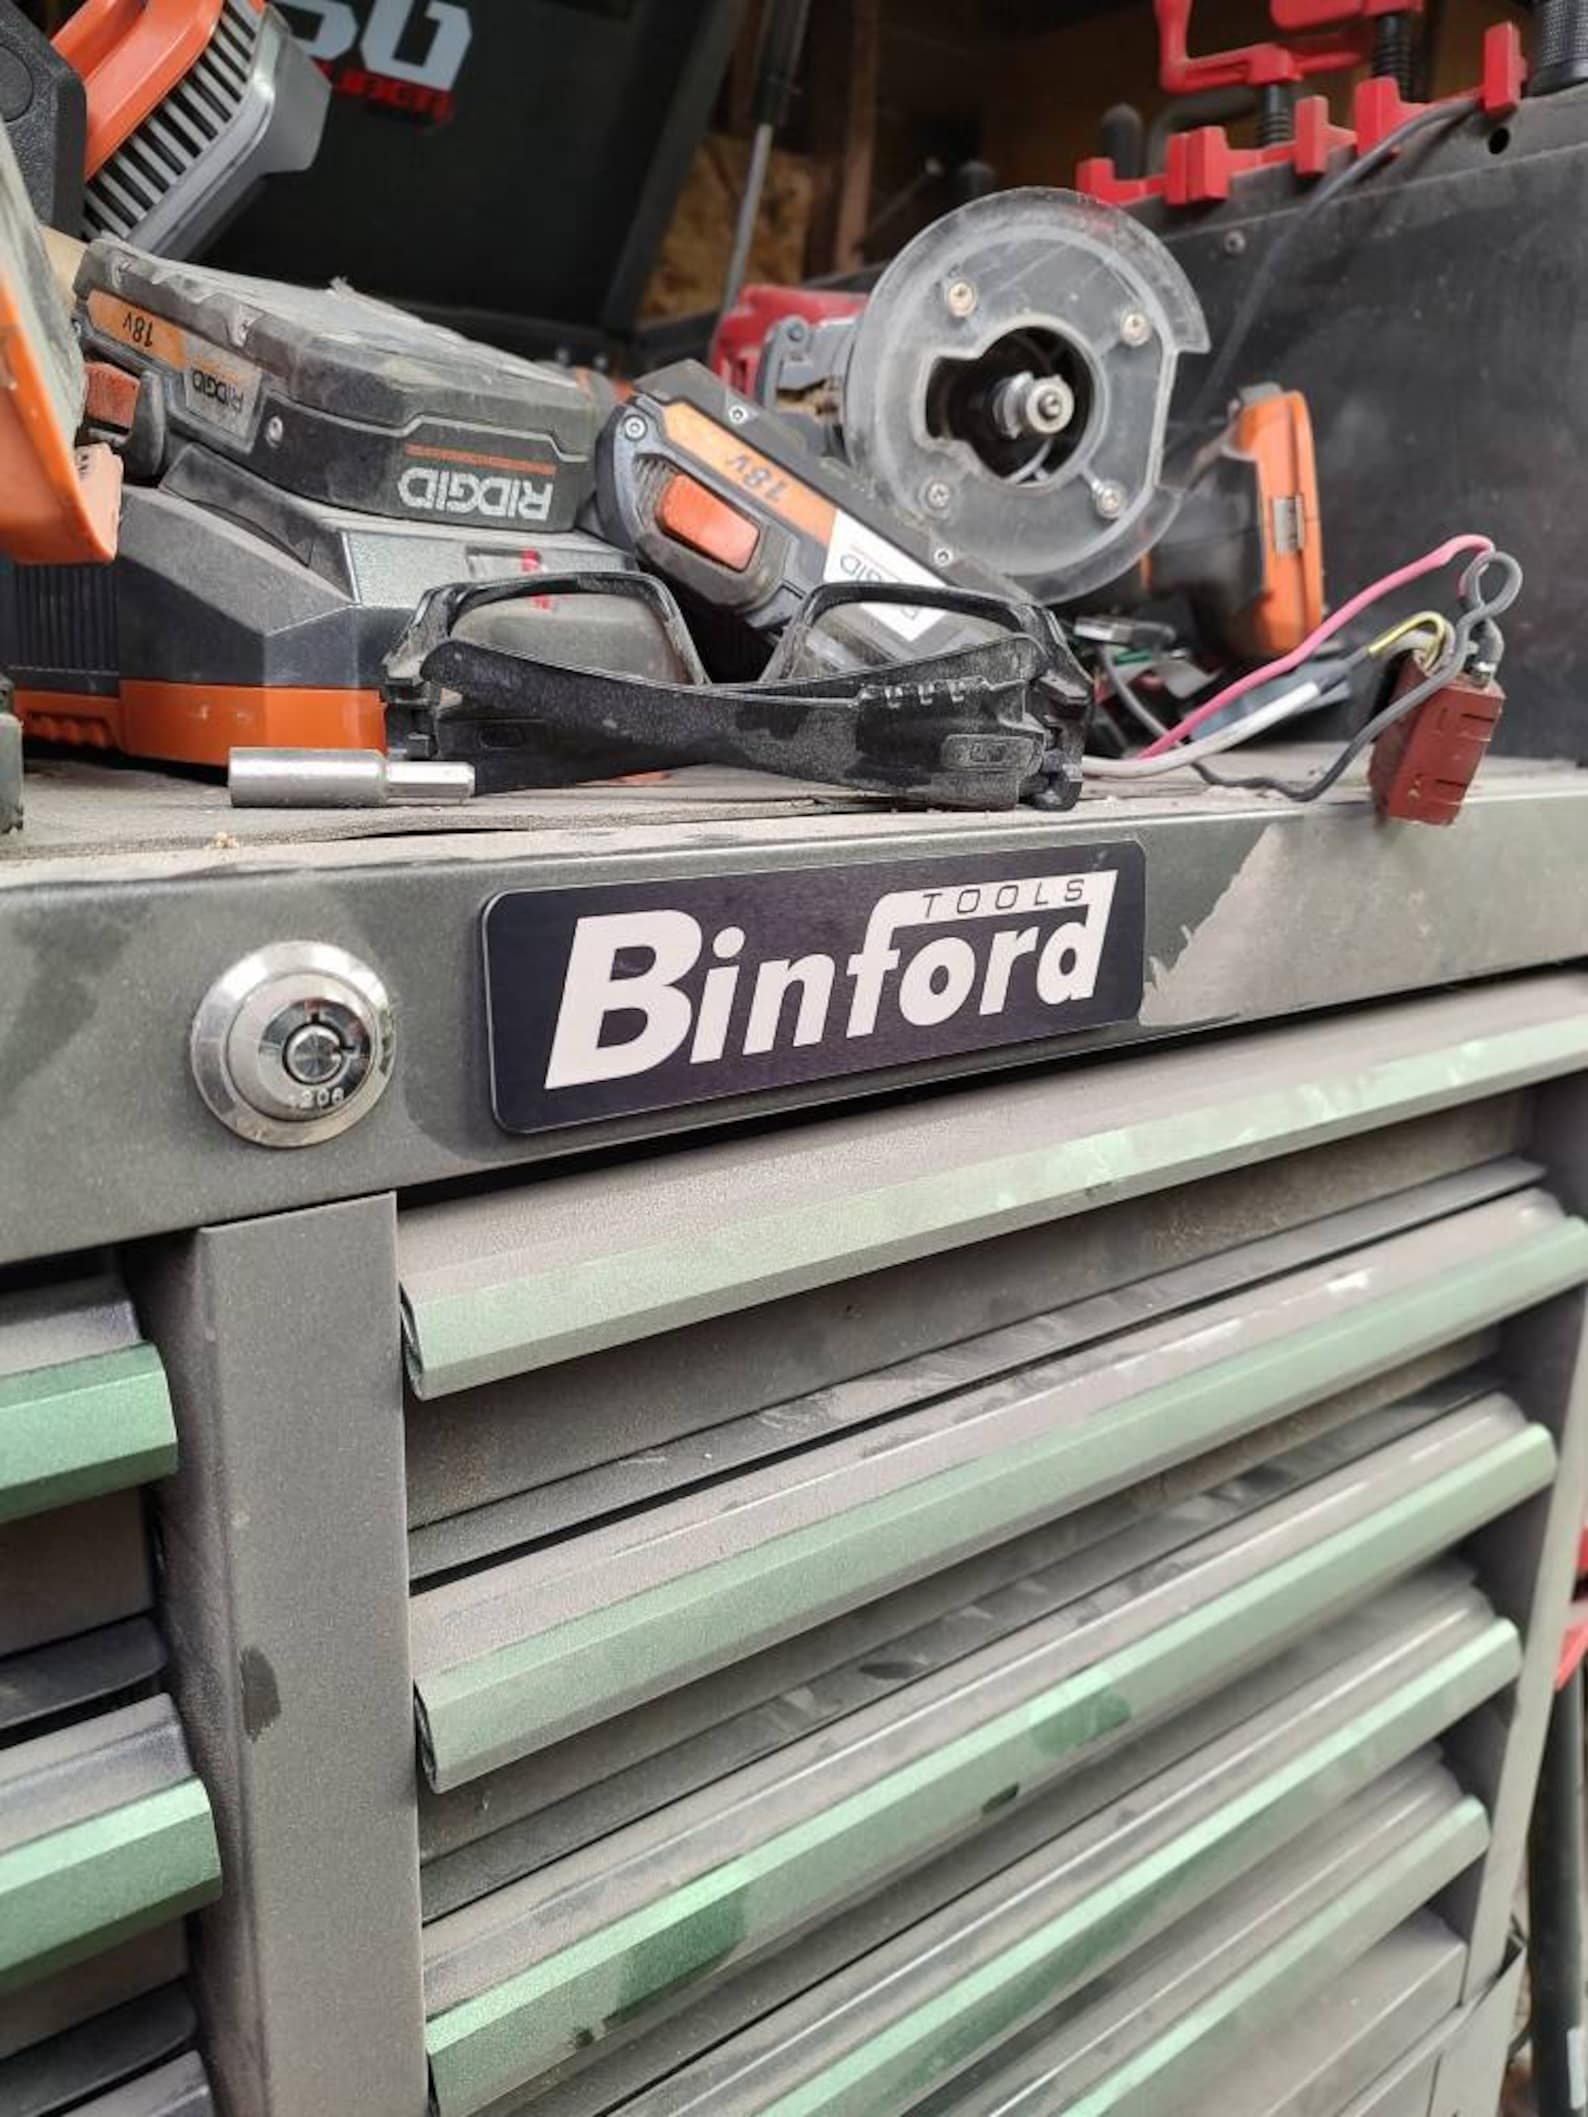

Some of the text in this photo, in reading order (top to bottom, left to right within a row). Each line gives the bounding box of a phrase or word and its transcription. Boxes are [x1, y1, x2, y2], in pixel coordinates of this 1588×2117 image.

[398, 466, 554, 521] RIDGID
[922, 877, 1086, 919] TOOLS
[544, 868, 1119, 1090] Binford
